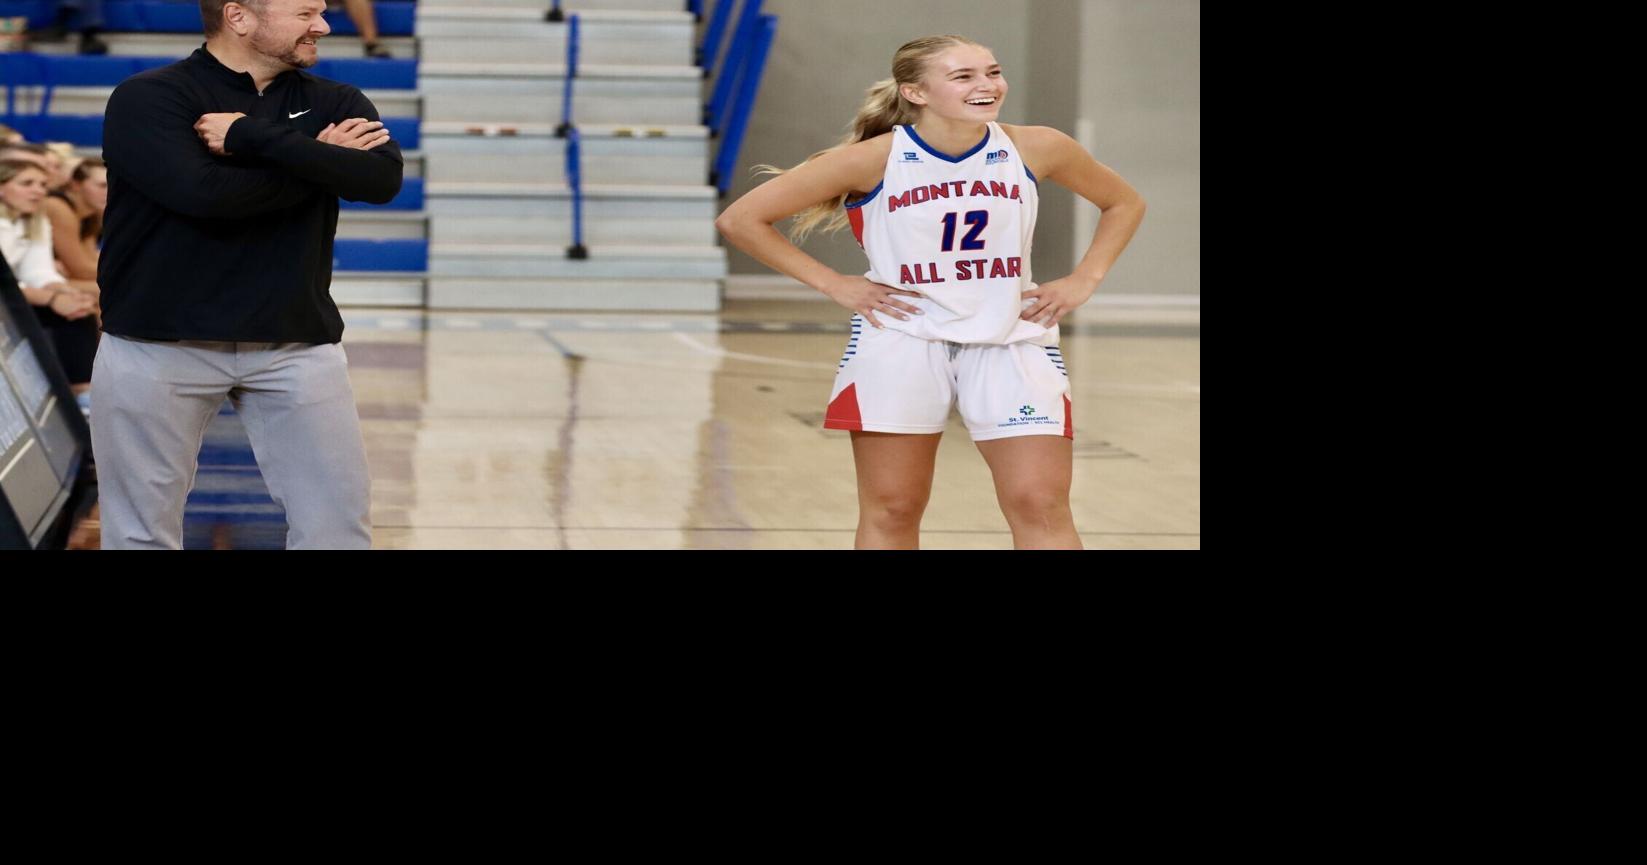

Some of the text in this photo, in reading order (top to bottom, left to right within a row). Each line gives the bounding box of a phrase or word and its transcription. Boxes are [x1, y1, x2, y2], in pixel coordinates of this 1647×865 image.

[888, 180, 1023, 213] MONTANA
[940, 209, 989, 252] 12
[900, 262, 945, 285] ALL
